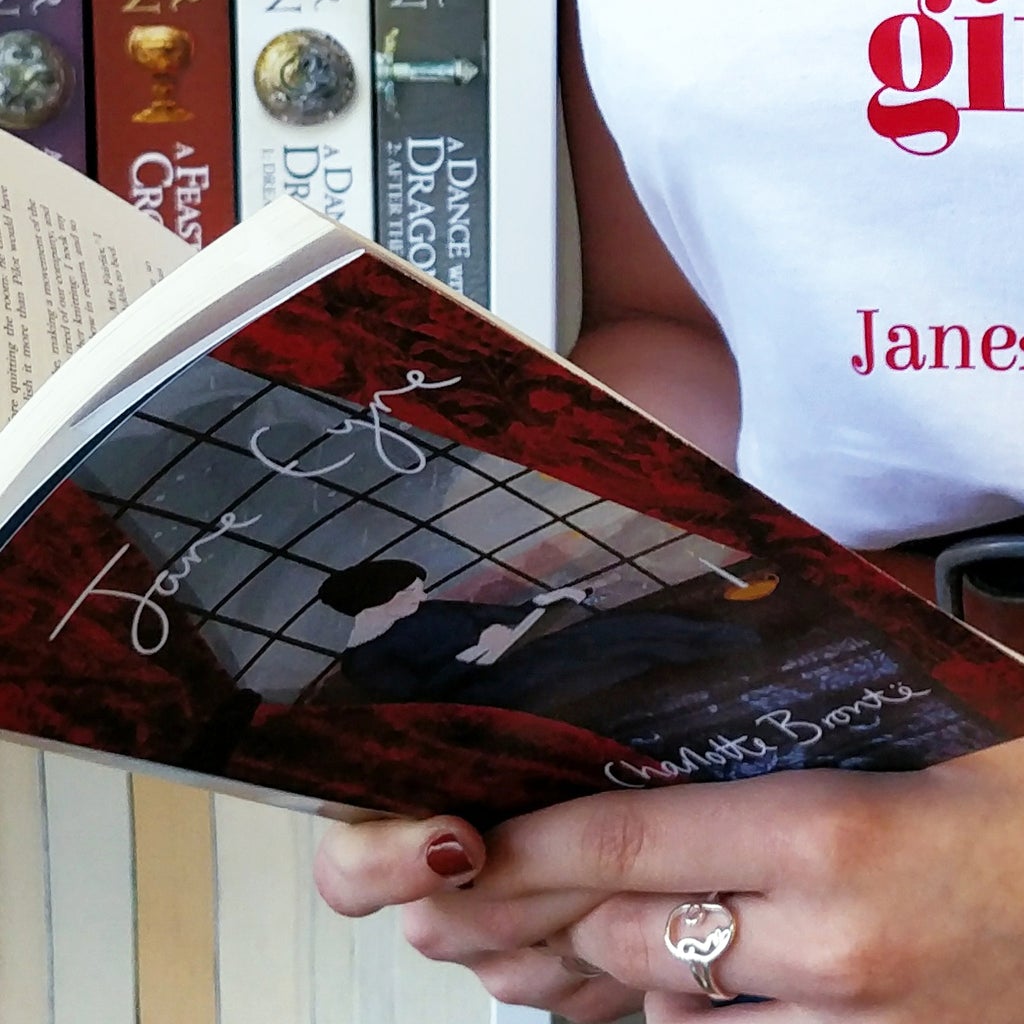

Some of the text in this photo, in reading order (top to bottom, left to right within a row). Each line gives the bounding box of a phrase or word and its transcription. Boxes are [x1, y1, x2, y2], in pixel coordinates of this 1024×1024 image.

[173, 141, 196, 160] A
[322, 144, 341, 159] A
[447, 136, 465, 153] A
[1, 184, 12, 212] have
[388, 158, 404, 216] AFTER
[39, 203, 53, 227] and
[448, 158, 478, 259] DANCE
[4, 213, 17, 252] would
[10, 256, 24, 287] Pilot
[35, 233, 52, 297] movement
[16, 291, 28, 319] than
[58, 308, 70, 324] of
[83, 303, 95, 314] in
[3, 316, 15, 336] the
[47, 308, 60, 355] making
[60, 324, 74, 356] tired
[20, 324, 33, 360] more
[7, 341, 21, 394] quitting
[22, 364, 33, 375] it
[48, 369, 463, 656] Jane Eyre
[604, 734, 778, 789] Charlotte
